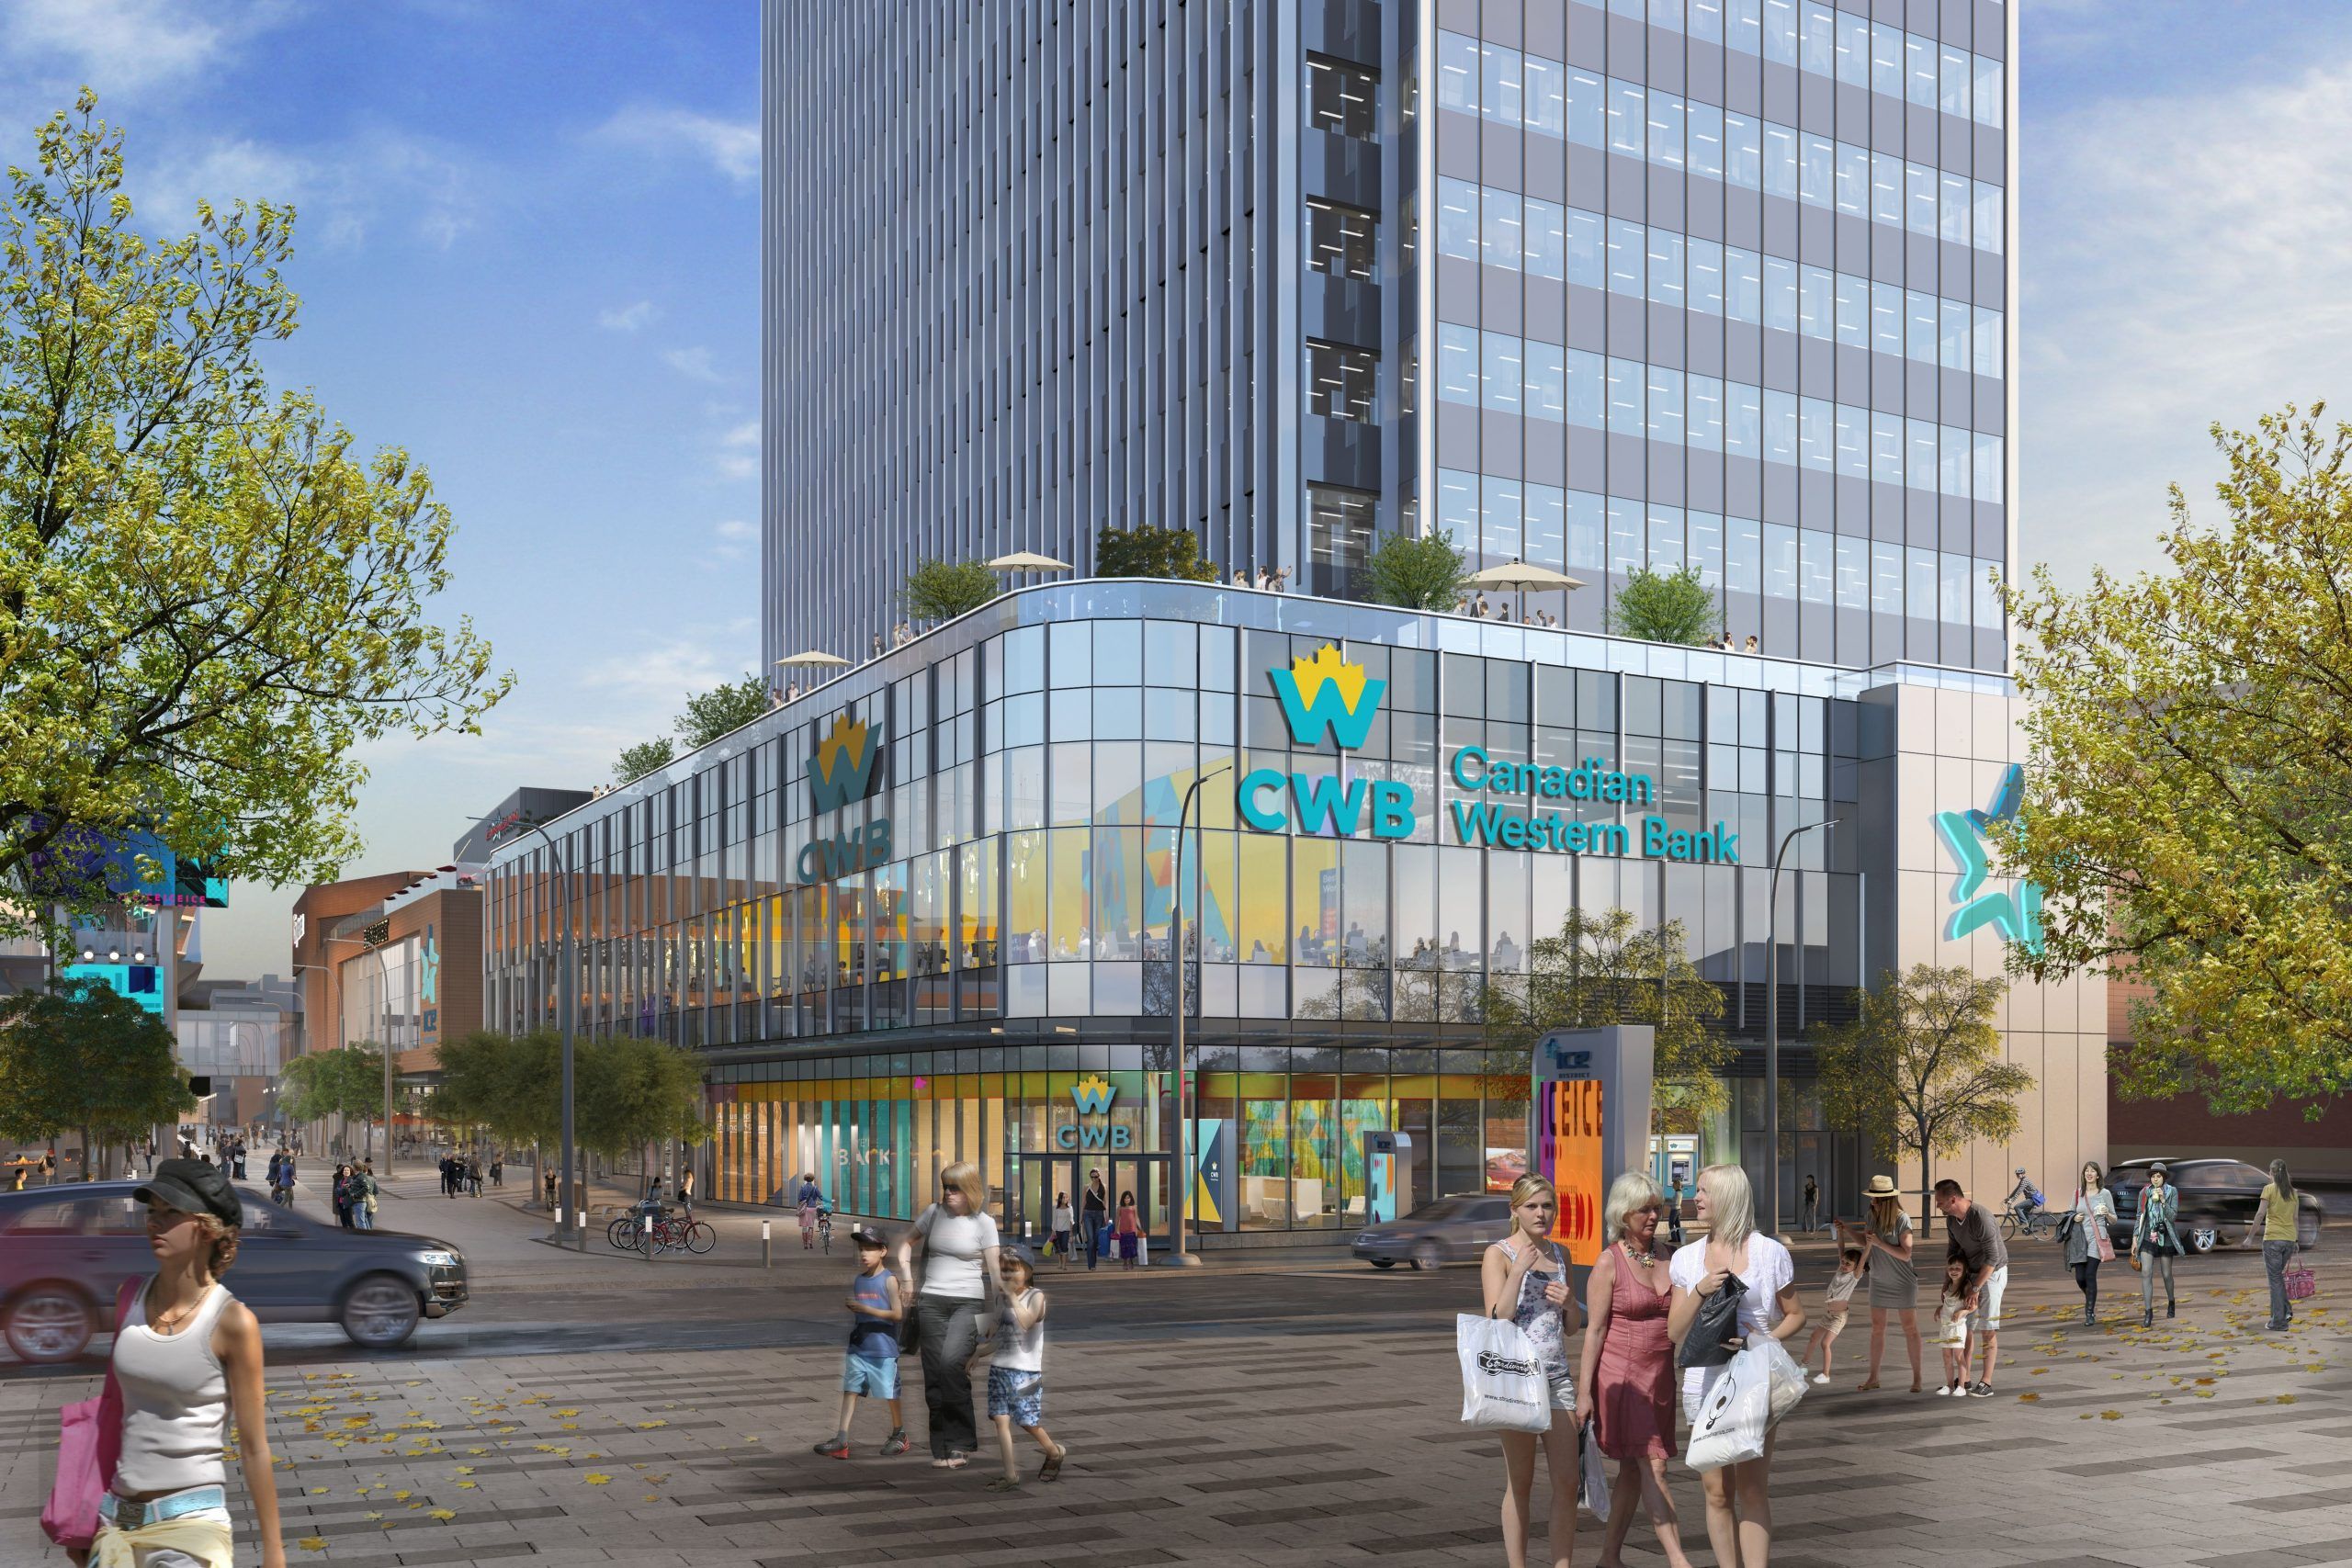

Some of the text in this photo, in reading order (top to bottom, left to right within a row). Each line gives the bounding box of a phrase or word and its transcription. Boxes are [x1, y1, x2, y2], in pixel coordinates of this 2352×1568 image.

[1238, 768, 1416, 838] CWB
[1454, 745, 1653, 804] Canadian
[797, 818, 892, 885] CWB
[1453, 798, 1740, 862] Western Bank
[1057, 1125, 1130, 1148] CWB
